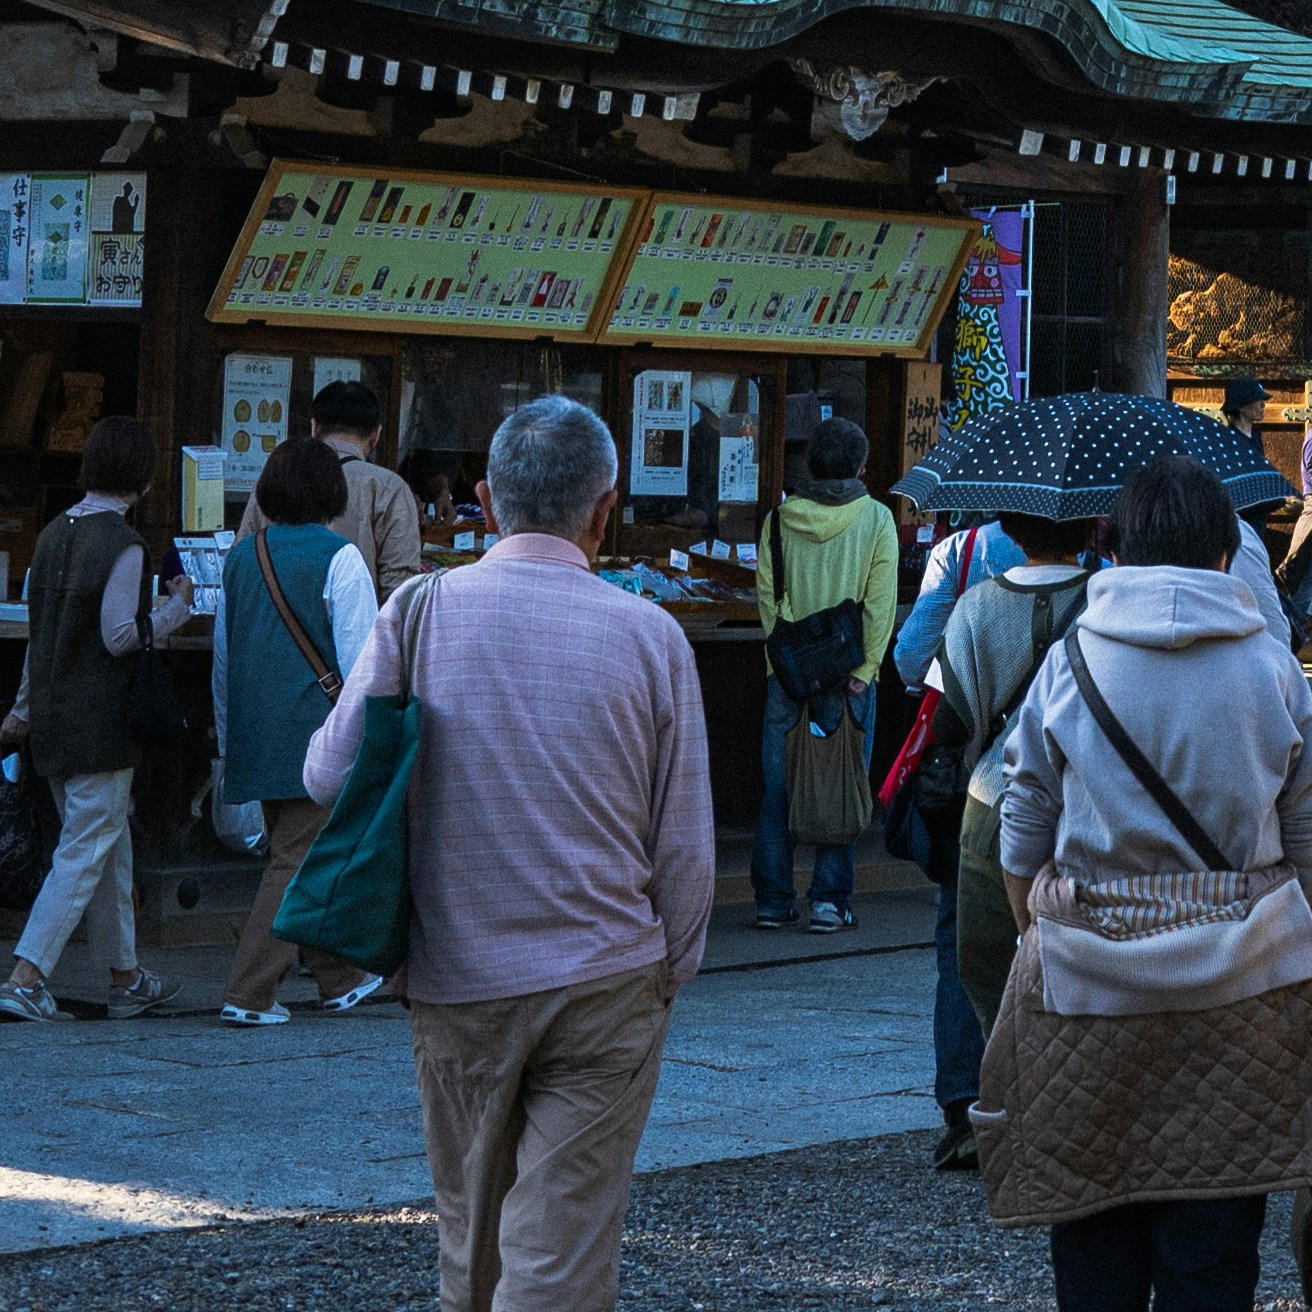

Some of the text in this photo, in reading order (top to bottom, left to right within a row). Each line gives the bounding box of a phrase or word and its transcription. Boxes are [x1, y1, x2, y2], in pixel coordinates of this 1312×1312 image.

[12, 178, 28, 247] 仕事守
[100, 237, 142, 265] 寅さん
[96, 274, 142, 294] お守り
